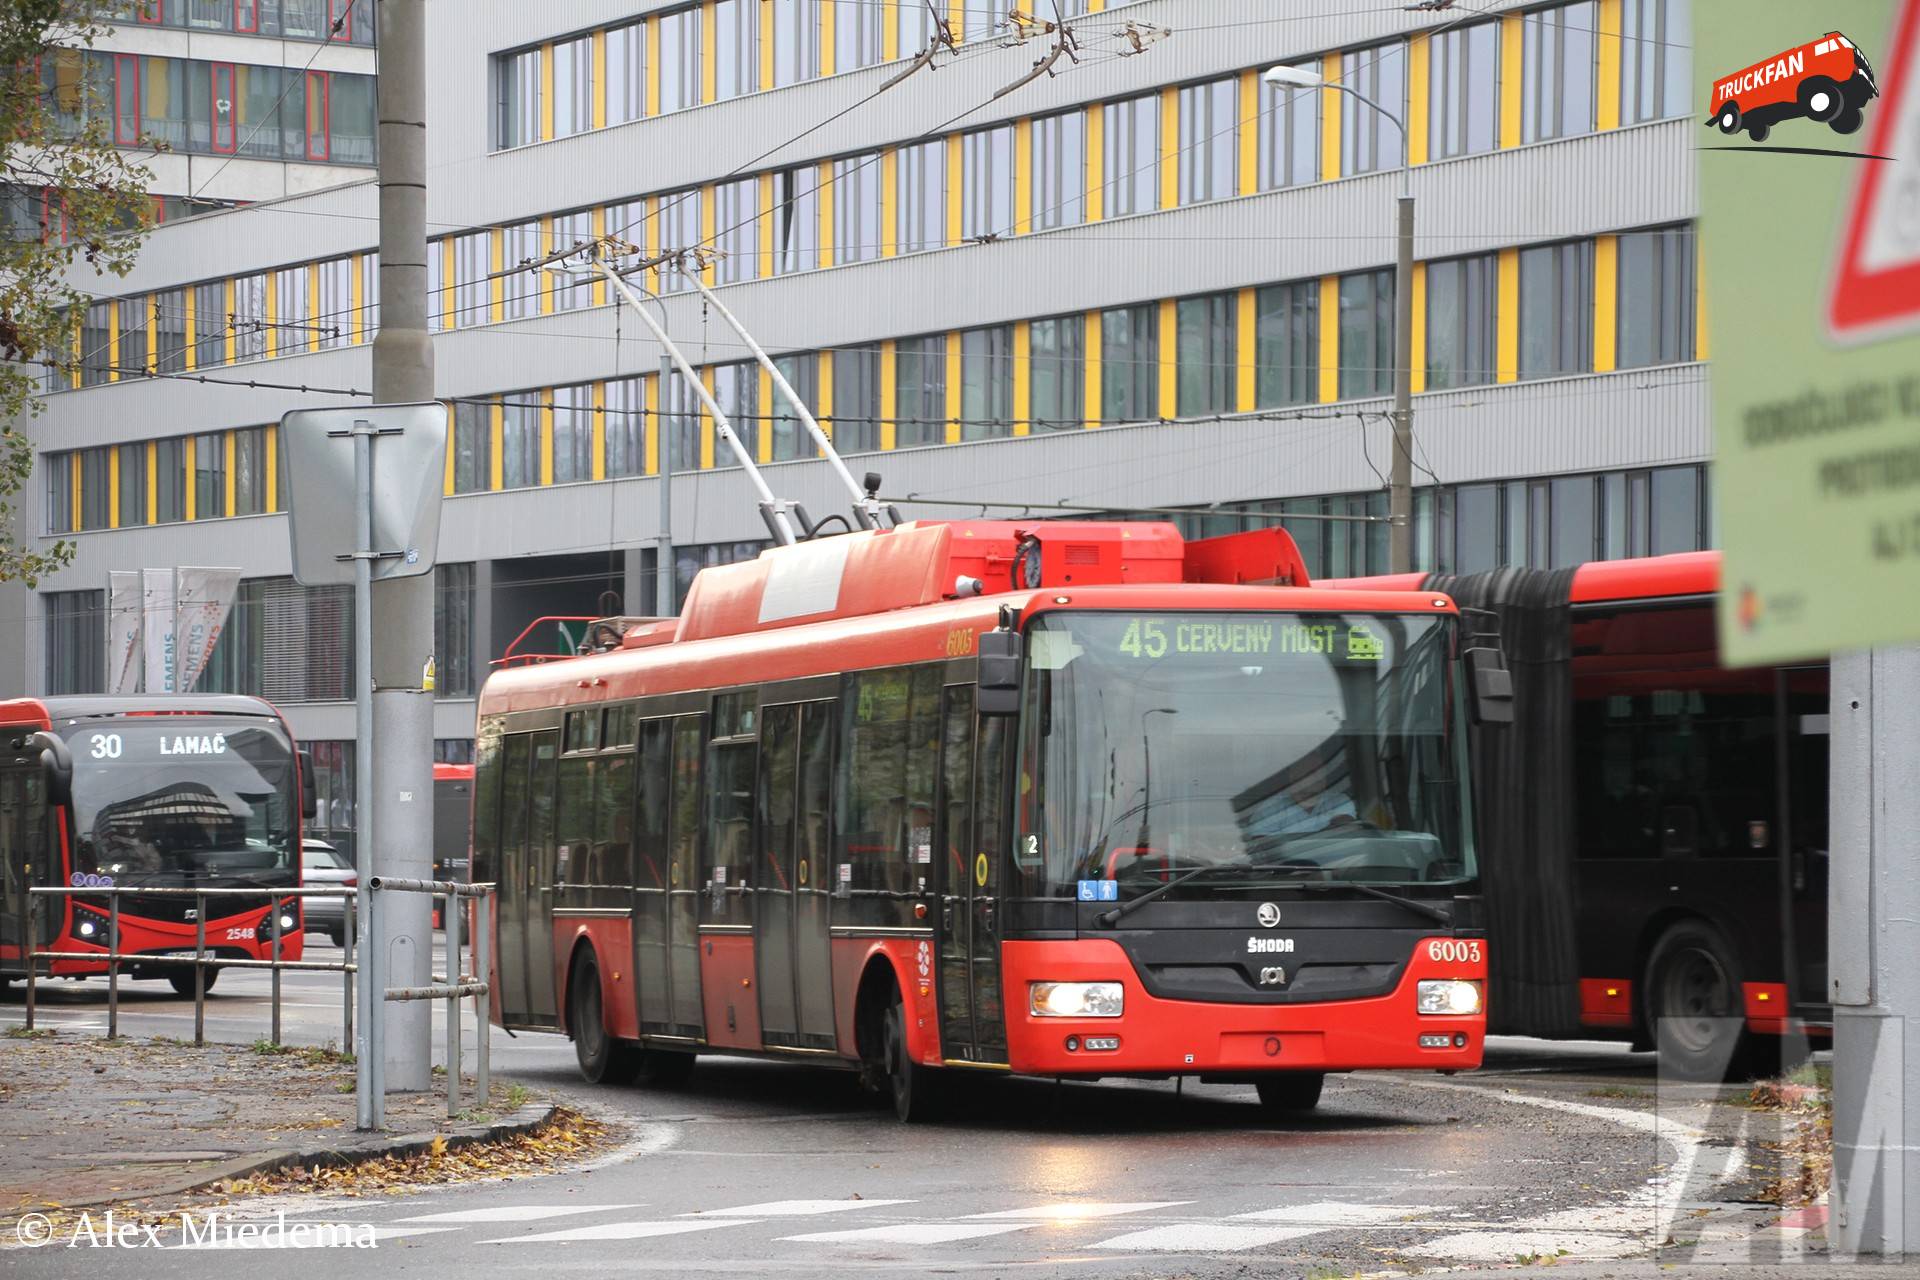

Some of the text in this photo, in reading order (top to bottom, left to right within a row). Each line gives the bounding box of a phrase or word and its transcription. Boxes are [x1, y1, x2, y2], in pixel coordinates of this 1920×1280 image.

[1119, 618, 1168, 658] 45
[1281, 624, 1336, 654] MOST
[164, 633, 175, 692] EMENS
[90, 733, 226, 759] 30 LAMAČ
[1028, 834, 1038, 854] 2
[226, 927, 256, 941] 2548
[1247, 936, 1295, 953] ŠKODA
[1428, 940, 1481, 963] 6003
